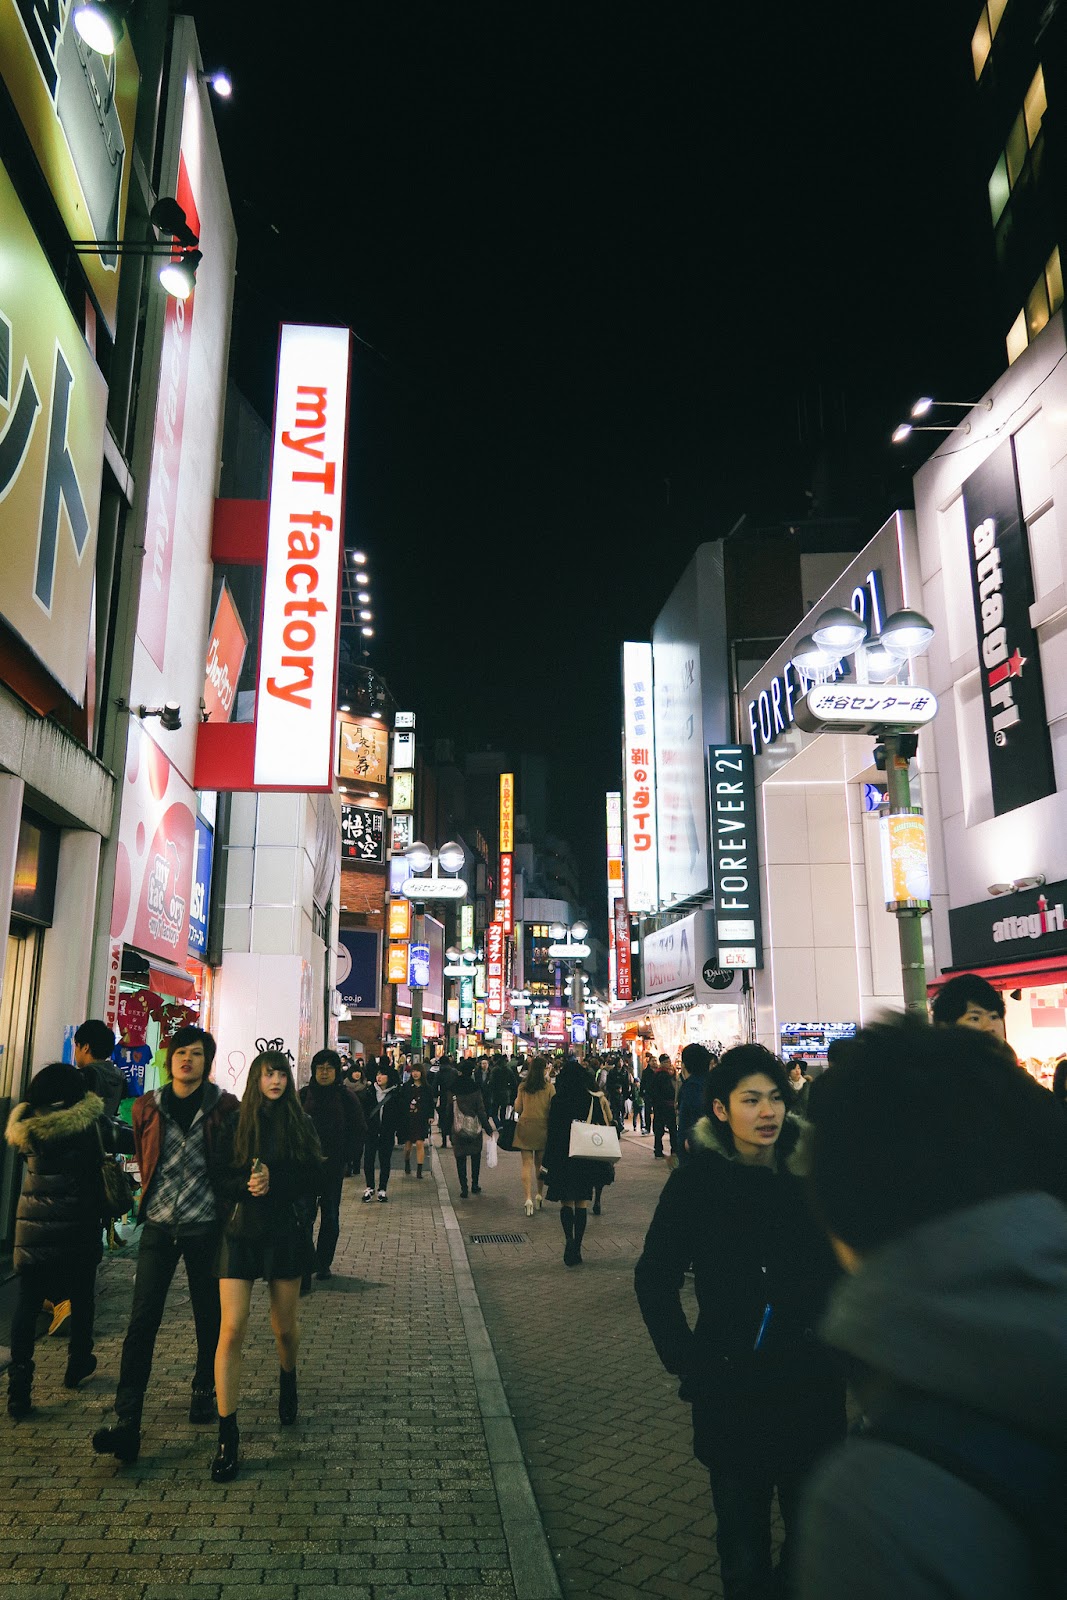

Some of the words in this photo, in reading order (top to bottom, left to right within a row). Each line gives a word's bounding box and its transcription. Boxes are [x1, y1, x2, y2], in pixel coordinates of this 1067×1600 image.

[281, 385, 337, 495] myT
[266, 510, 333, 710] factory
[973, 518, 1027, 733] attagirl
[816, 693, 930, 711] 渋谷センター街
[376, 774, 386, 783] 4F
[714, 749, 743, 773] 21
[631, 748, 651, 852] 靴のダイワ
[342, 814, 378, 858] 悟空
[716, 781, 750, 909] FOREVER
[992, 894, 1065, 943] attagirl
[111, 944, 121, 970] we
[108, 975, 117, 1006] can
